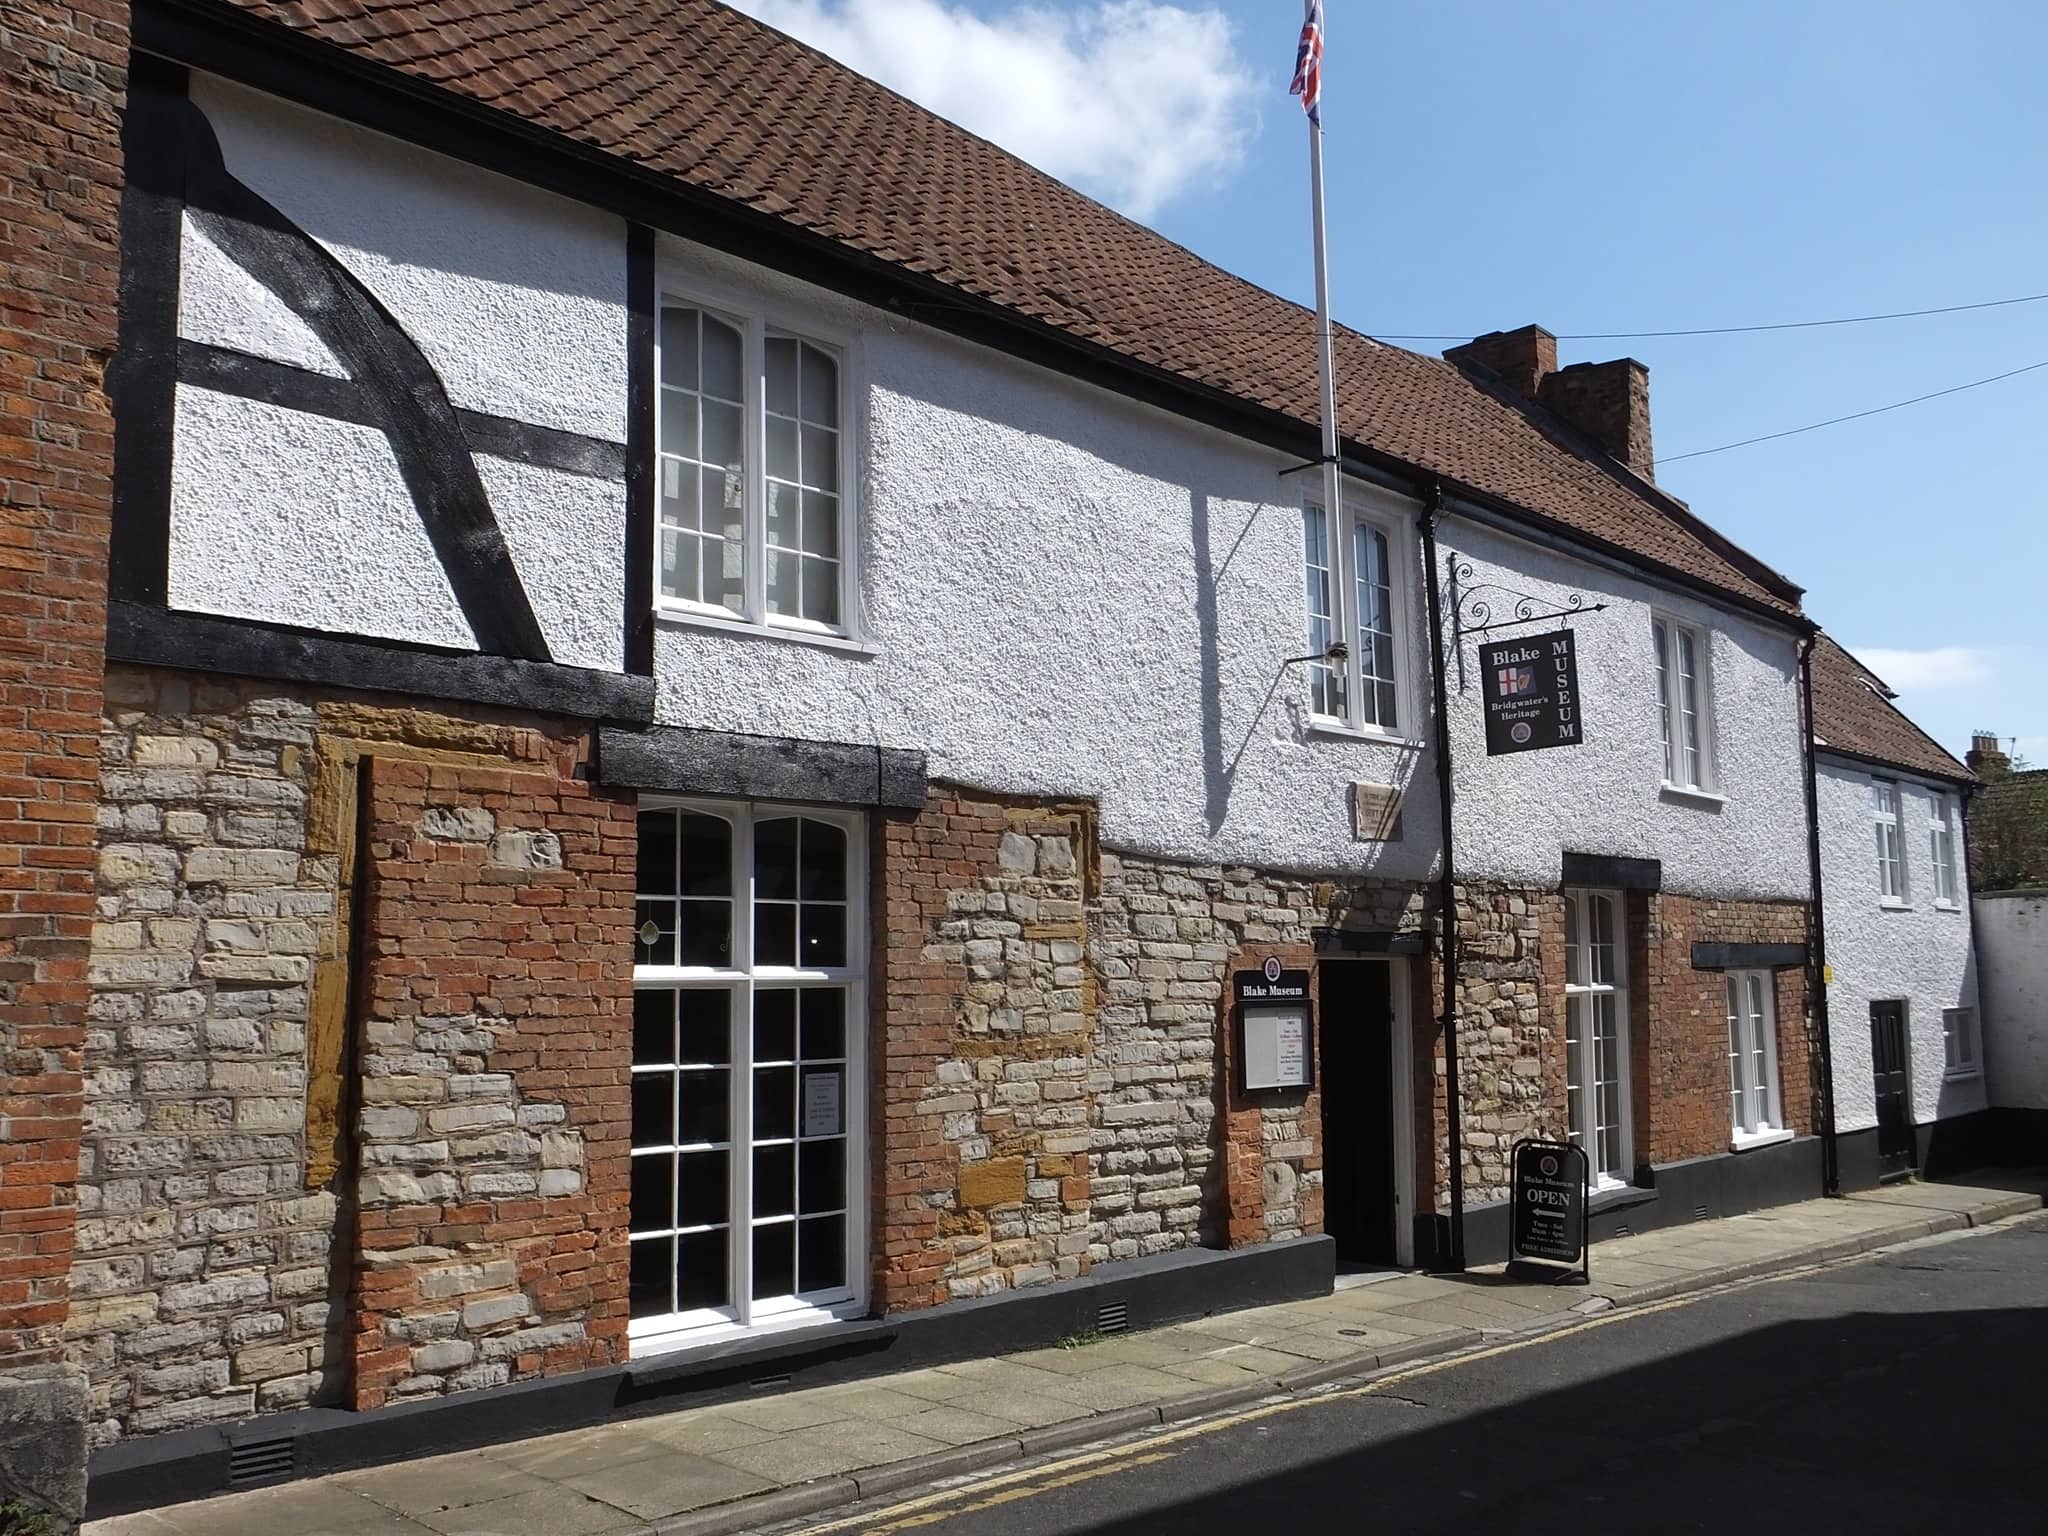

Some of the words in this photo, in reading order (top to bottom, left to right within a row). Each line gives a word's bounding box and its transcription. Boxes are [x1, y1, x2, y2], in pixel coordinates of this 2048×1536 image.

[1492, 648, 1540, 665] Blake
[1552, 640, 1575, 738] MUSEUM
[1491, 696, 1549, 711] Bridgwater's
[1501, 709, 1541, 720] Heritage
[1243, 985, 1267, 996] Blake
[1269, 985, 1303, 996] Museum
[1524, 1176, 1543, 1184] Blake
[1545, 1178, 1575, 1187] Museum
[1527, 1189, 1570, 1206] OPEN
